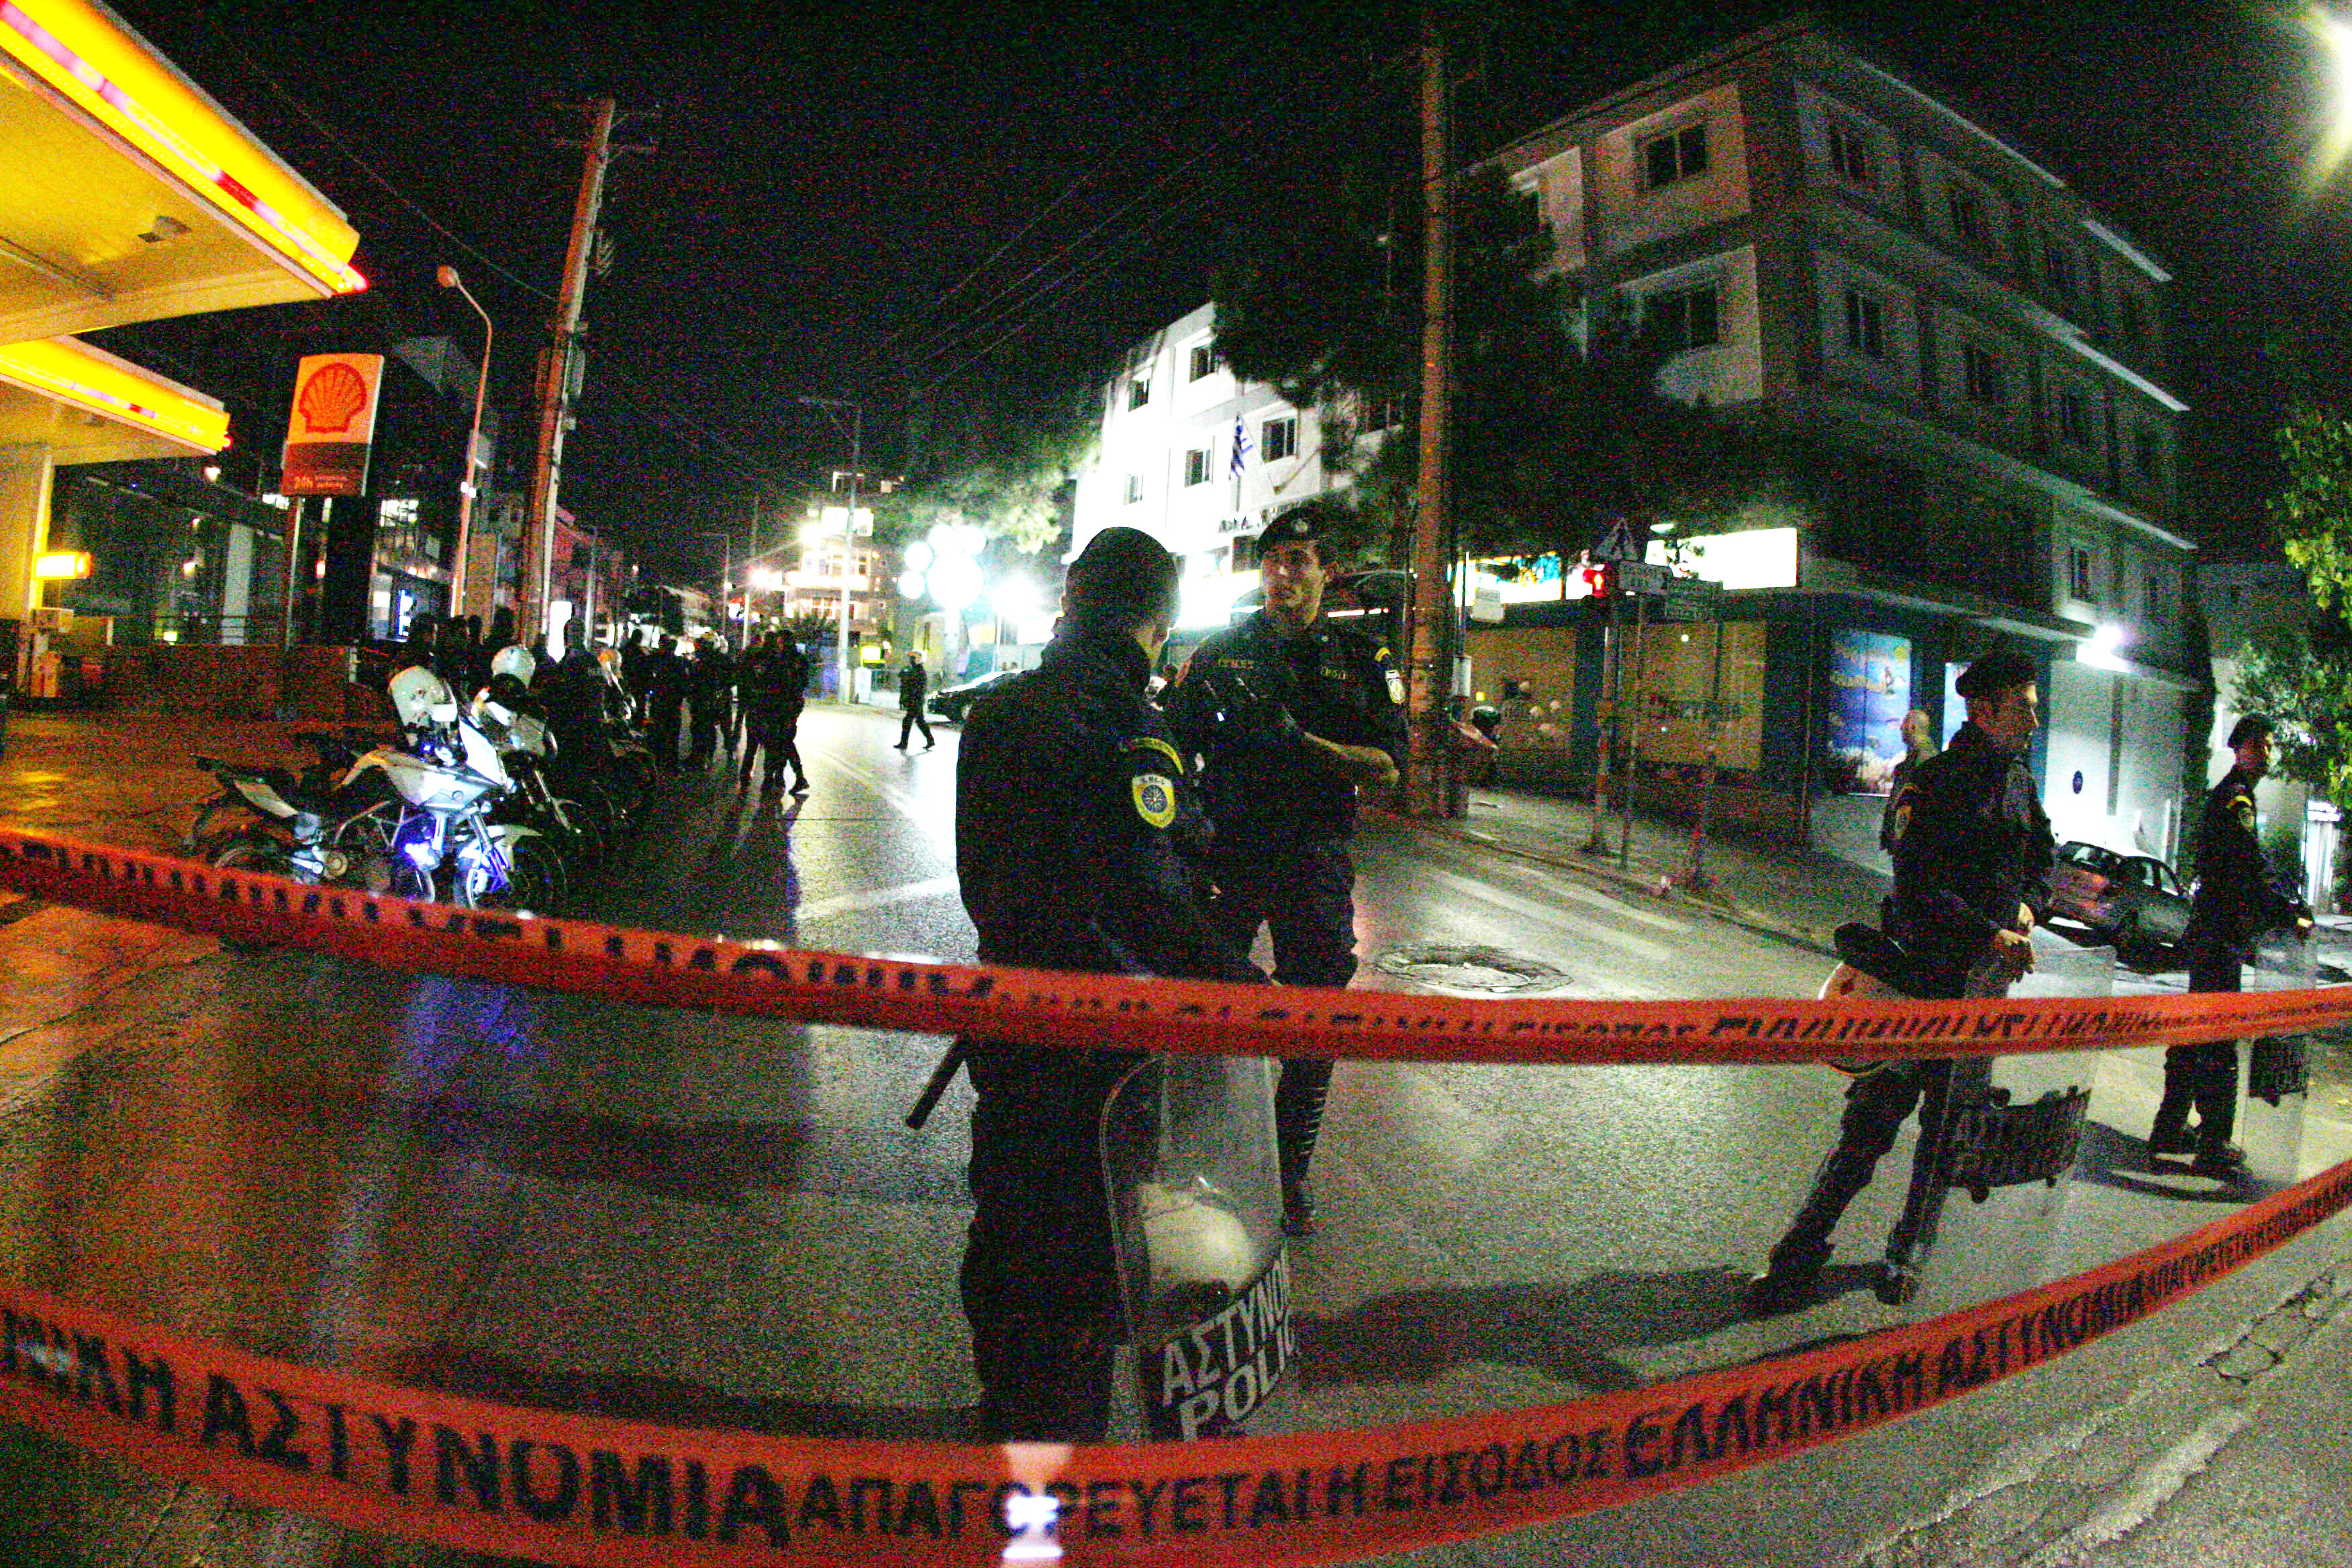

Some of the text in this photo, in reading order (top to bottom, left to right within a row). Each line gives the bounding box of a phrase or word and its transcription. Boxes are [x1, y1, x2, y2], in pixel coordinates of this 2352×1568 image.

[201, 1372, 789, 1547] ΑΣΤΥΝΟΜΙΑ
[1328, 1462, 1371, 1516] Η
[1384, 1428, 1611, 1511] ΕΙΣΟΔΟΣ
[1624, 1348, 1922, 1476] ΕΛΛΗΝΙΚΗ
[1937, 1271, 2145, 1397] ΑΣΤΥΝΟΜΙΑ
